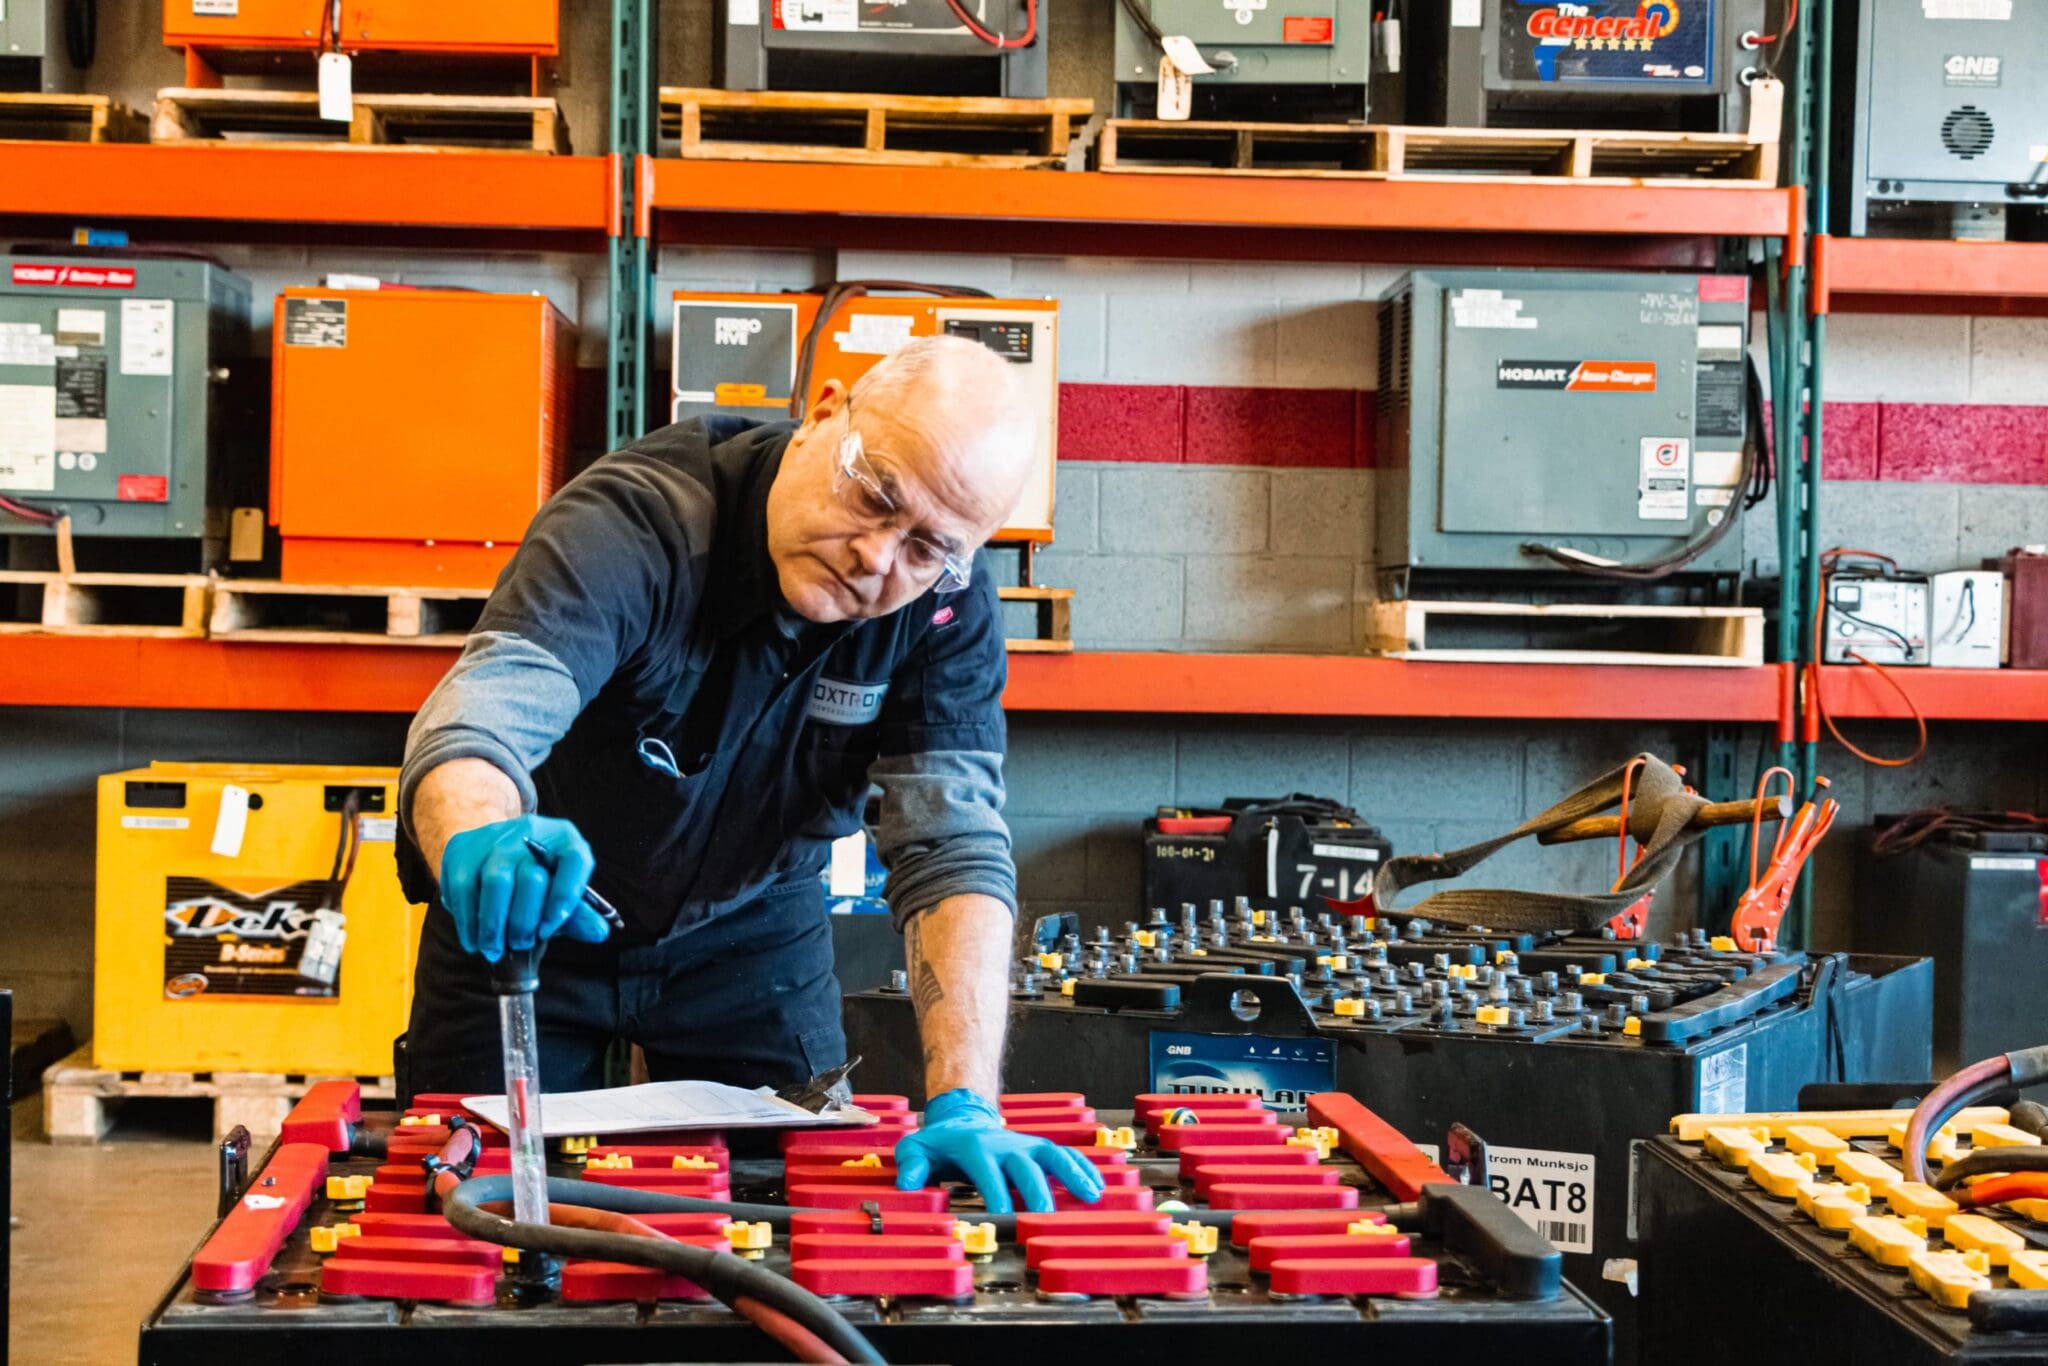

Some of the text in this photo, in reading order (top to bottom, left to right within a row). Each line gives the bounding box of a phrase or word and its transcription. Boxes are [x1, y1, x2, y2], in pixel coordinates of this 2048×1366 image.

[1558, 3, 1588, 17] The
[1527, 8, 1661, 39] General
[1945, 55, 2000, 75] GNB
[1499, 368, 1567, 382] HOBART
[1167, 1046, 1192, 1056] GNB
[1527, 1157, 1589, 1172] Munksjo
[1488, 1173, 1587, 1214] BAT8
